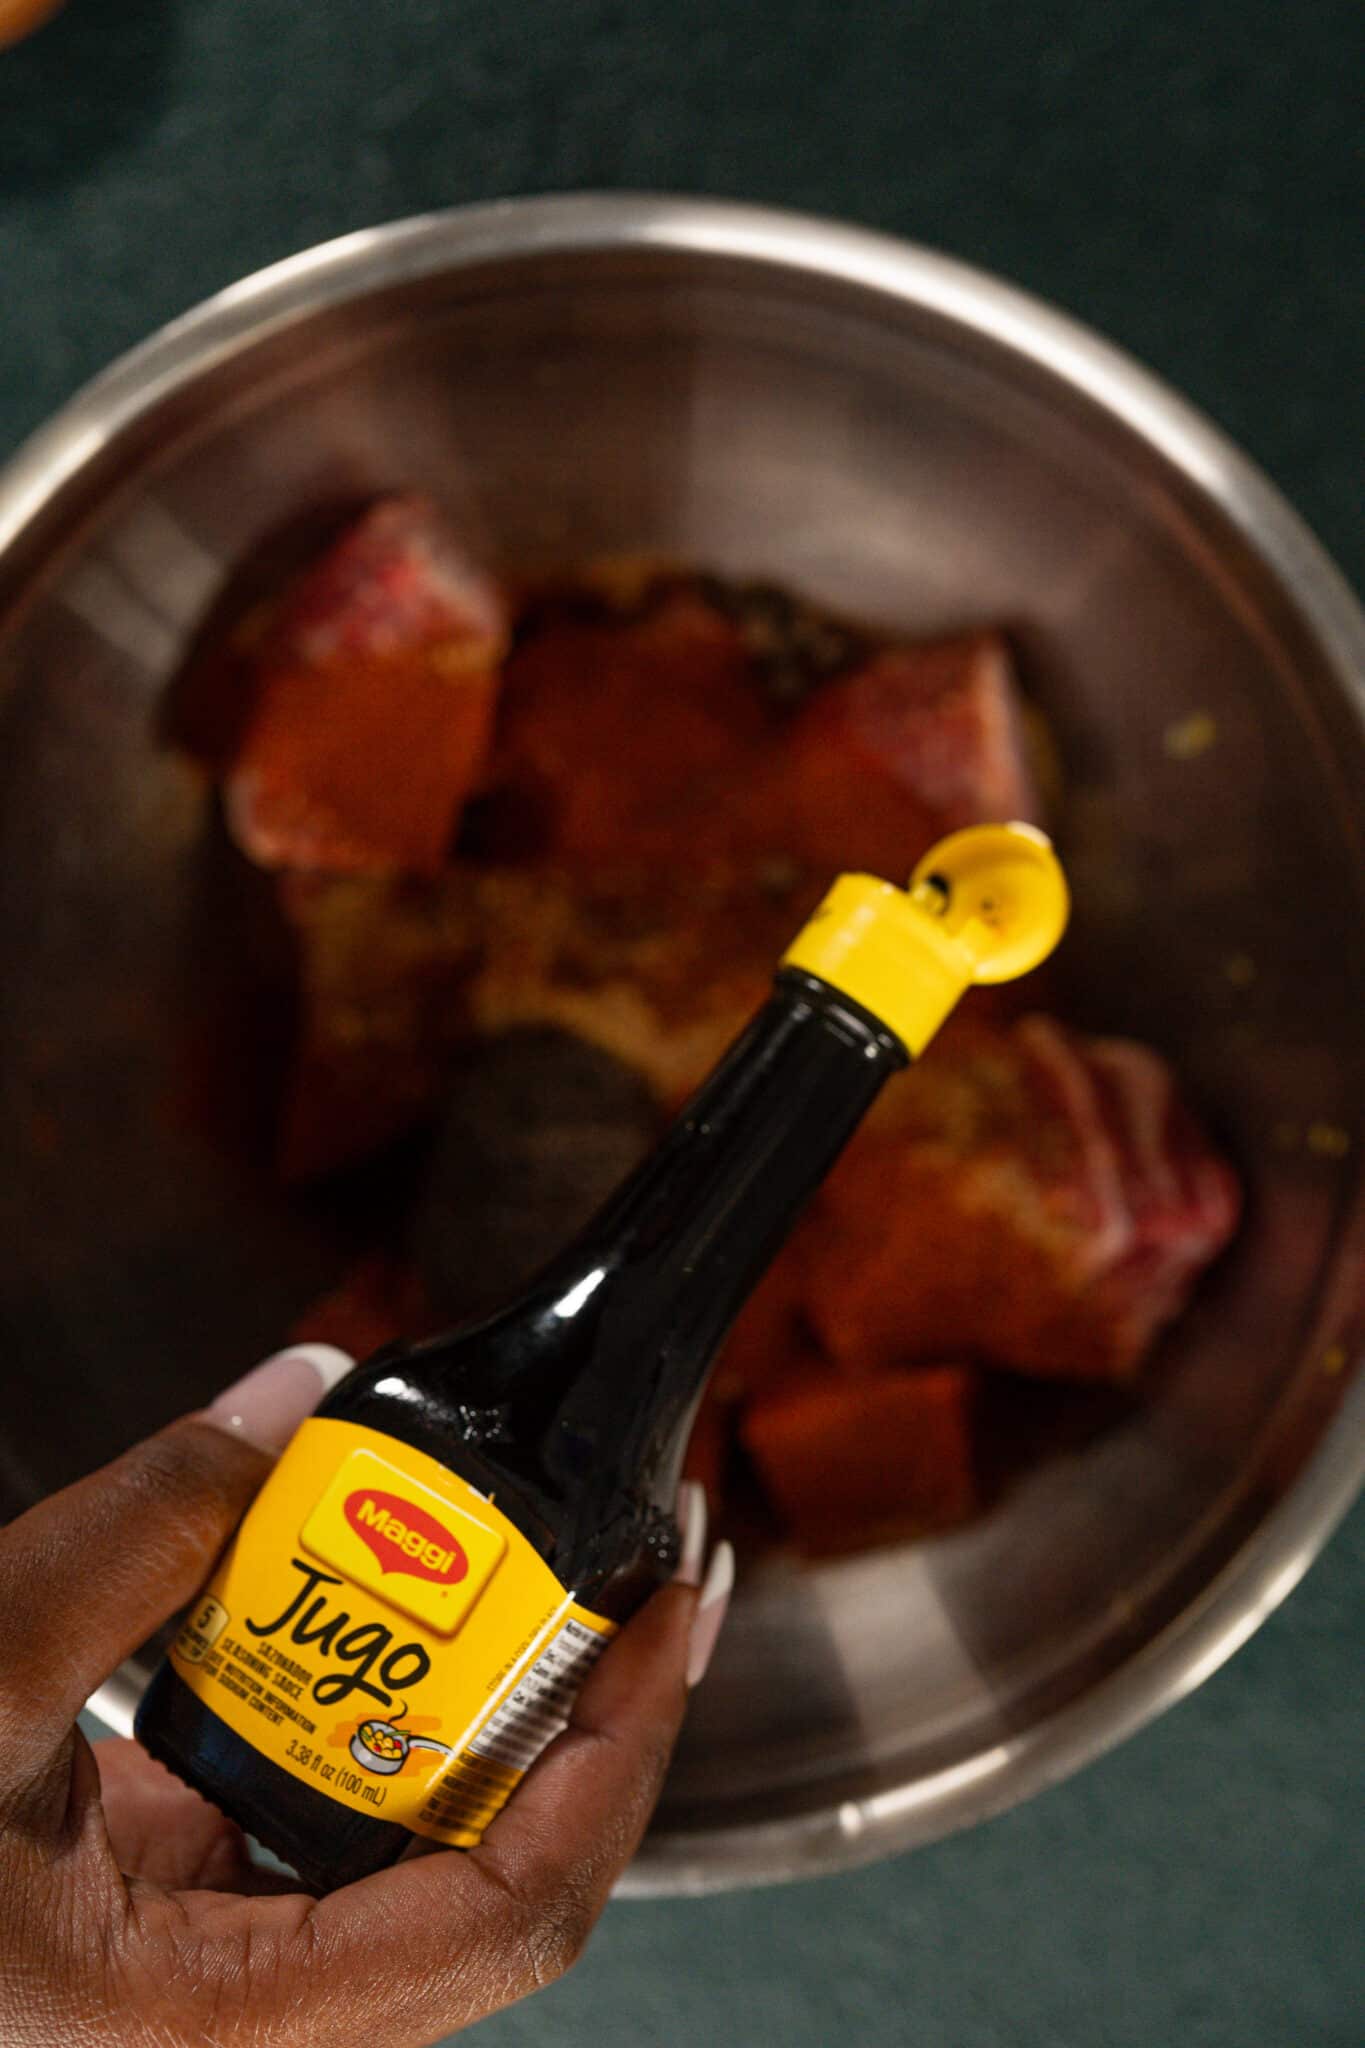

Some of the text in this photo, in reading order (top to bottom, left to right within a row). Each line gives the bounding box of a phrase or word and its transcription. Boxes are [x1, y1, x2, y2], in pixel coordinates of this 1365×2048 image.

[357, 1499, 456, 1574] Maggi
[197, 1605, 216, 1629] 5
[245, 1557, 431, 1708] Jugo
[222, 1638, 272, 1678] SEASONING
[272, 1672, 304, 1701] SAUCE
[256, 1642, 312, 1685] SAZONADOR
[224, 1662, 265, 1695] NUTRITION
[264, 1691, 316, 1735] INFORMATION
[248, 1696, 285, 1726] CONTENT
[285, 1739, 387, 1808] 3.38 fl oz (100 mL)
